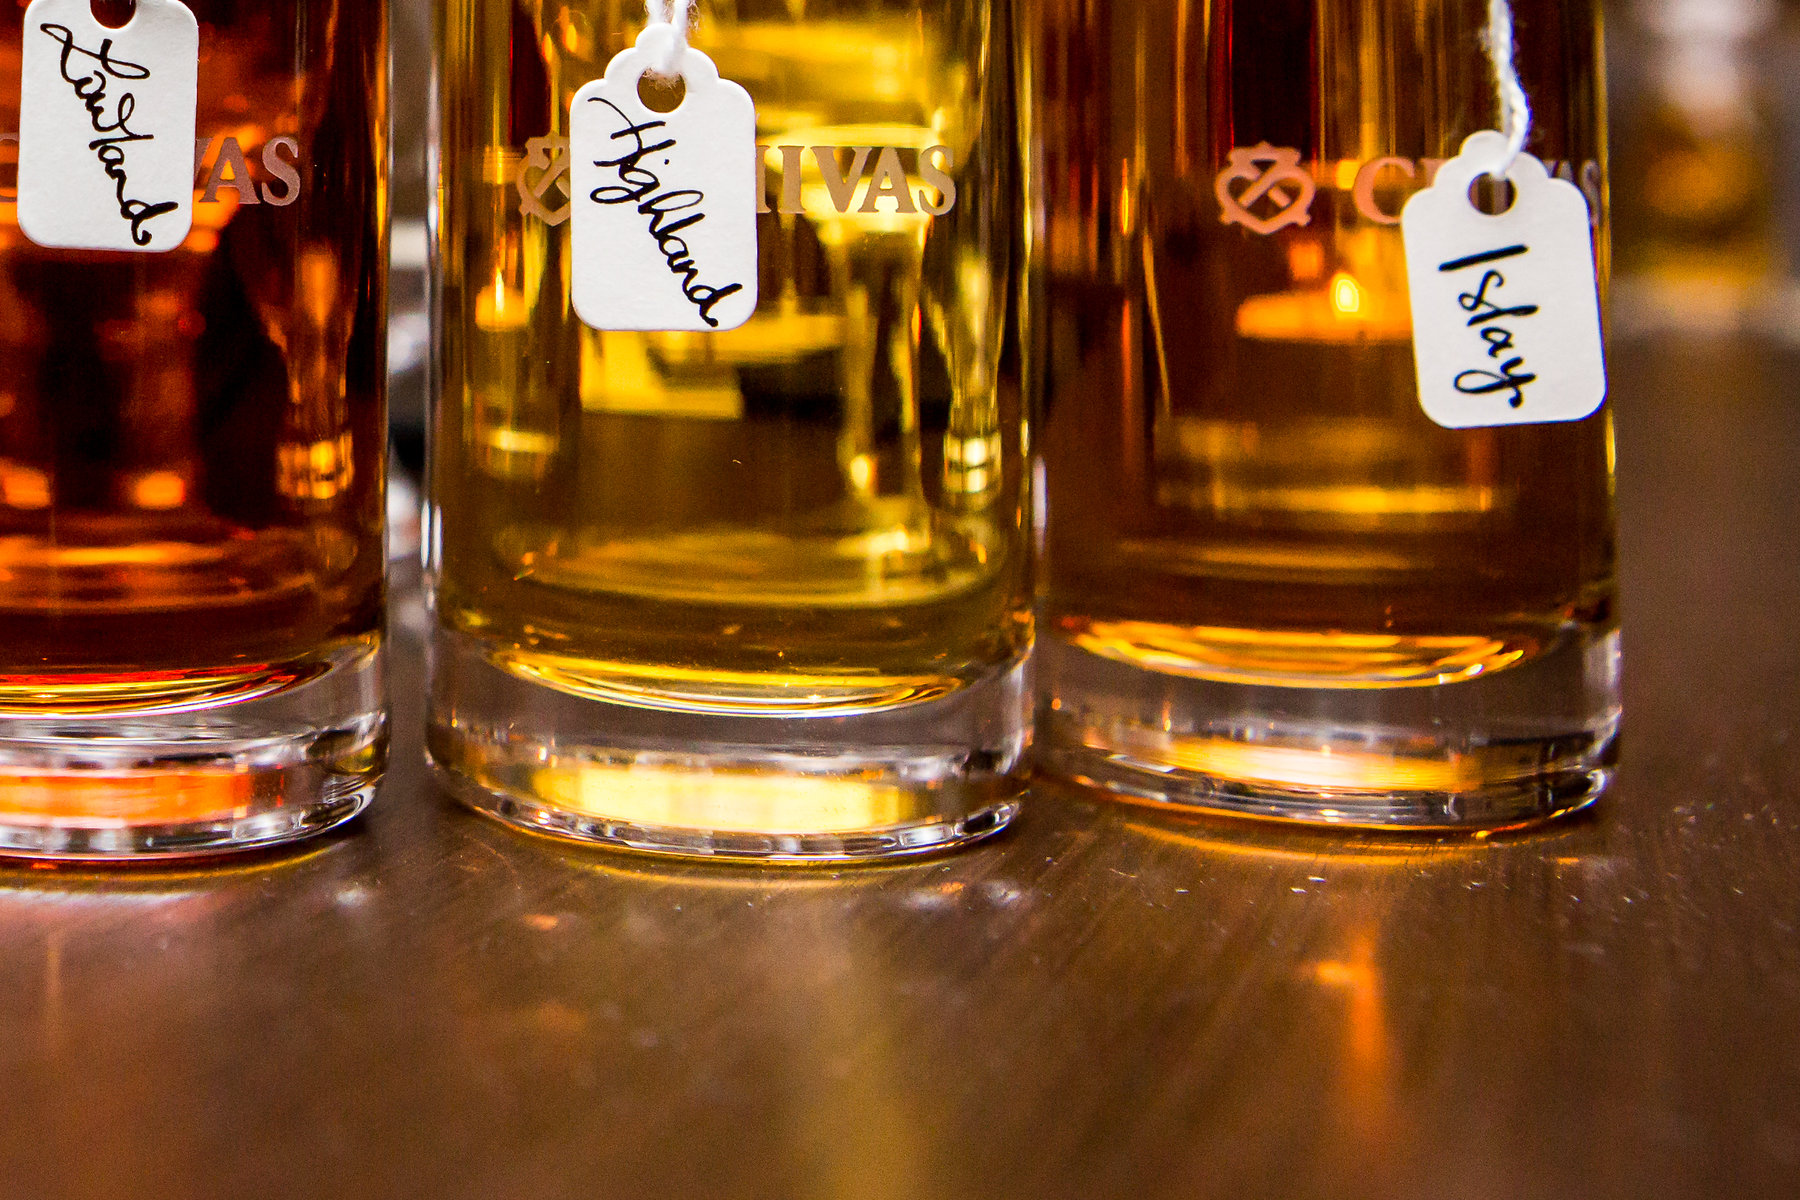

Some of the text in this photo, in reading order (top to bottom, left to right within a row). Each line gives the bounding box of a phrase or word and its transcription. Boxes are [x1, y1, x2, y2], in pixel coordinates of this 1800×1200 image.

[39, 22, 179, 246] Lowland
[587, 96, 744, 328] Highland
[756, 145, 957, 216] IVAS
[1437, 244, 1540, 409] Islay
